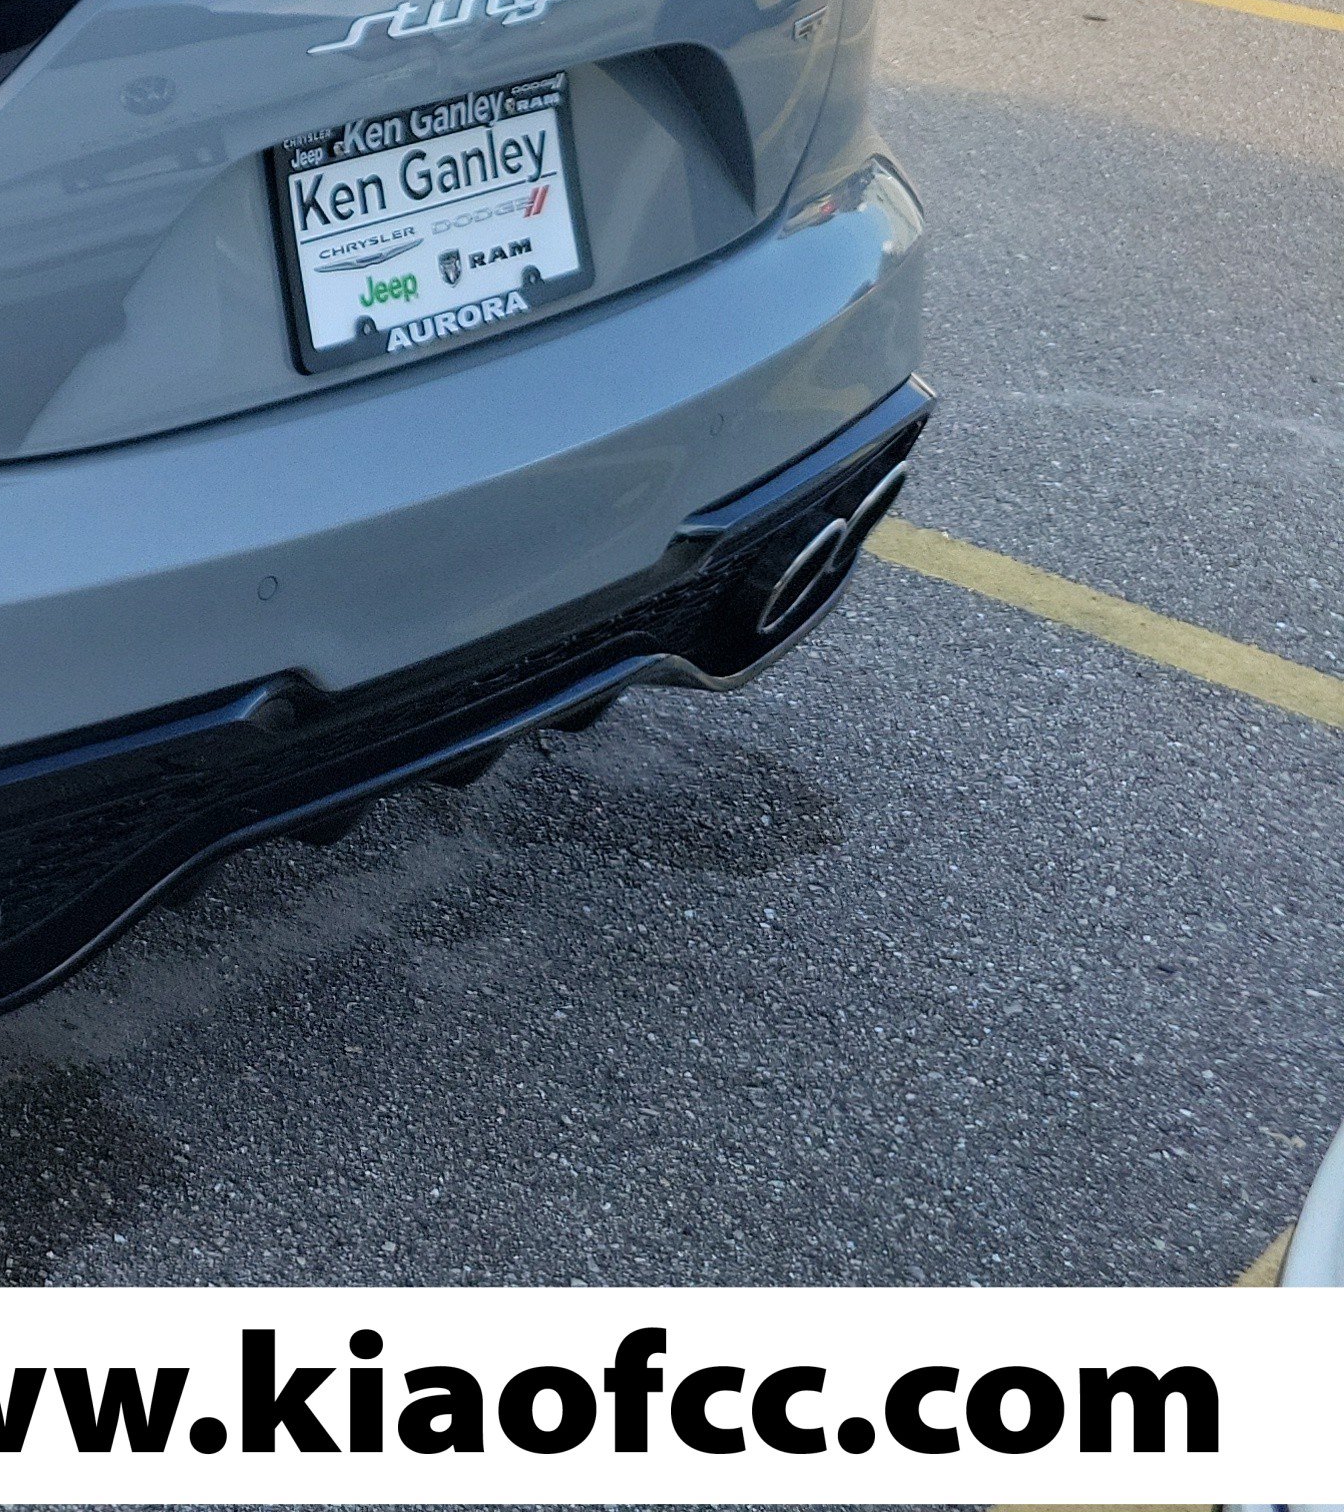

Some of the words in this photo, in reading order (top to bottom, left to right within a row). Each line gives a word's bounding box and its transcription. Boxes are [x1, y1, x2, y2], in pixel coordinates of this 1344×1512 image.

[515, 92, 561, 113] RAM
[342, 119, 402, 155] Ken
[410, 90, 505, 138] Ganley
[290, 146, 324, 170] Jeep
[293, 171, 388, 232] Ken
[398, 128, 548, 202] Ganley
[430, 195, 535, 236] DODGE
[318, 225, 416, 260] CHRYSLER
[467, 237, 533, 270] RAM
[358, 273, 419, 308] Jeep
[386, 290, 529, 353] AURORA
